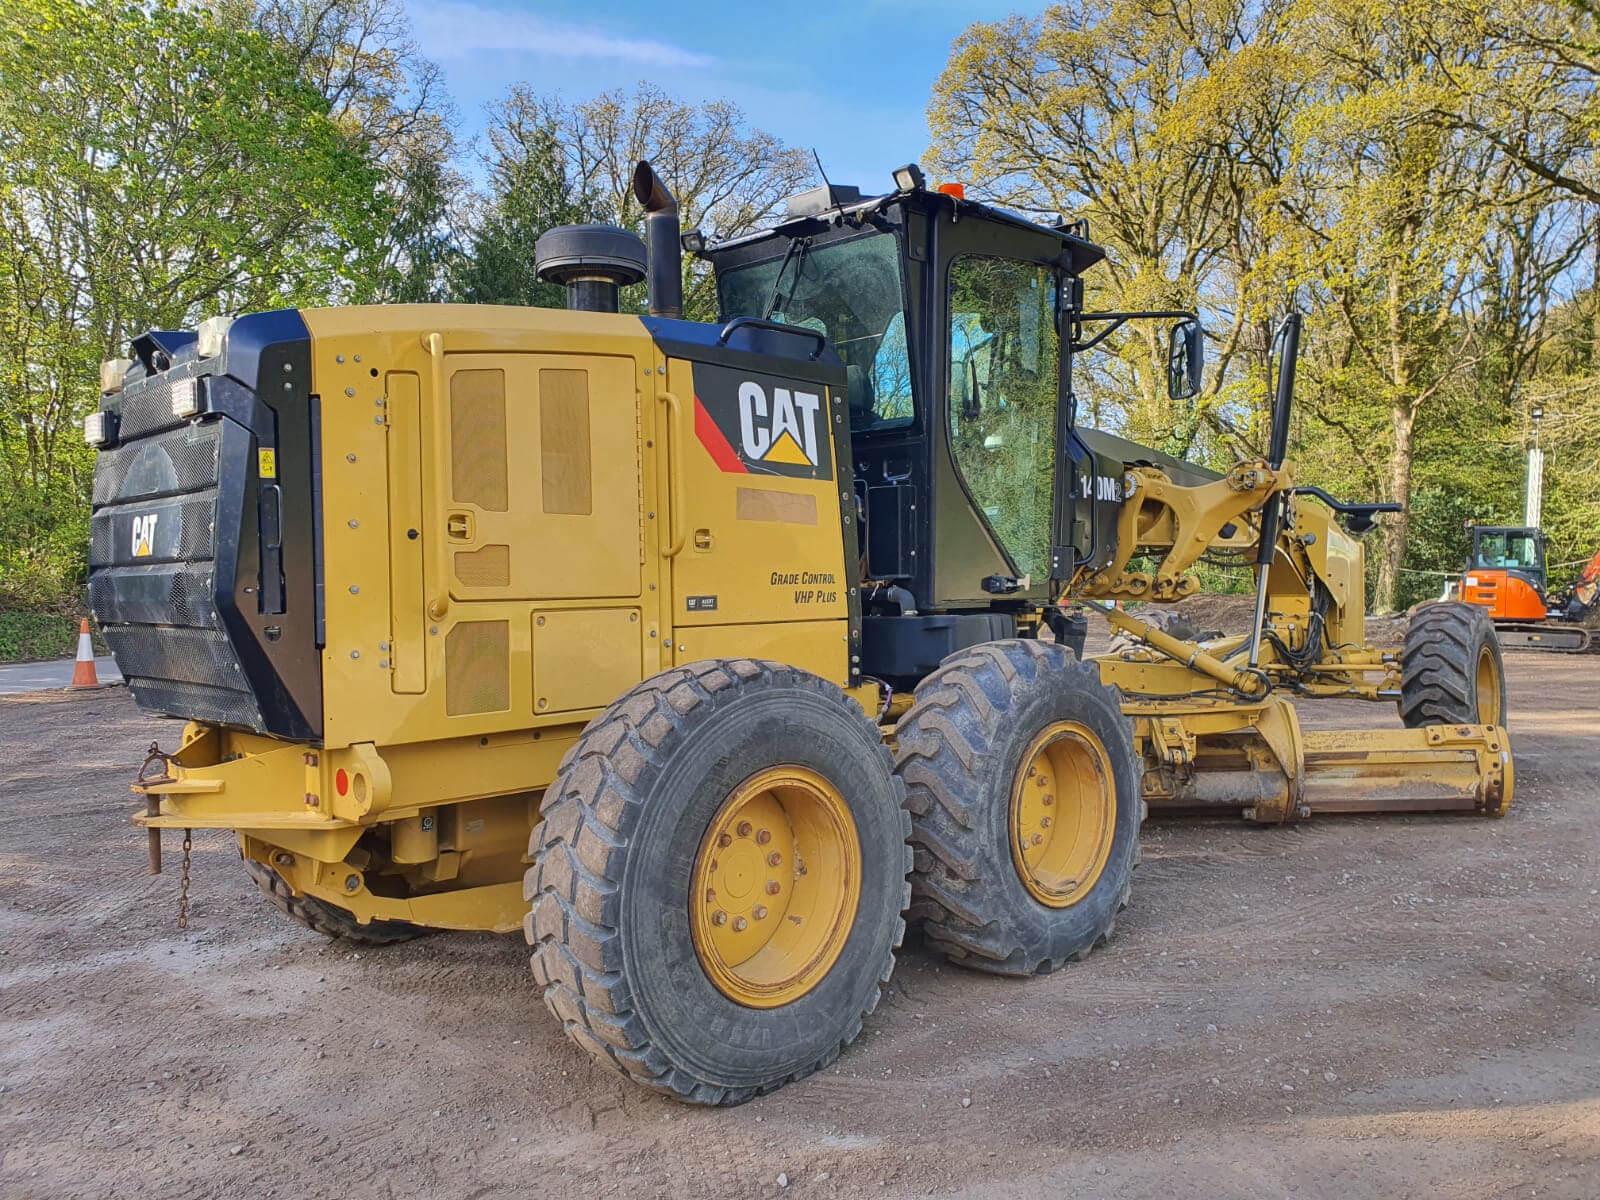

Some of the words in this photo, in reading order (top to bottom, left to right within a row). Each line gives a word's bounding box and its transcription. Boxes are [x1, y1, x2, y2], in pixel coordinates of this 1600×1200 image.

[738, 381, 819, 467] CAT
[132, 514, 158, 557] CAT
[794, 590, 814, 604] VHP
